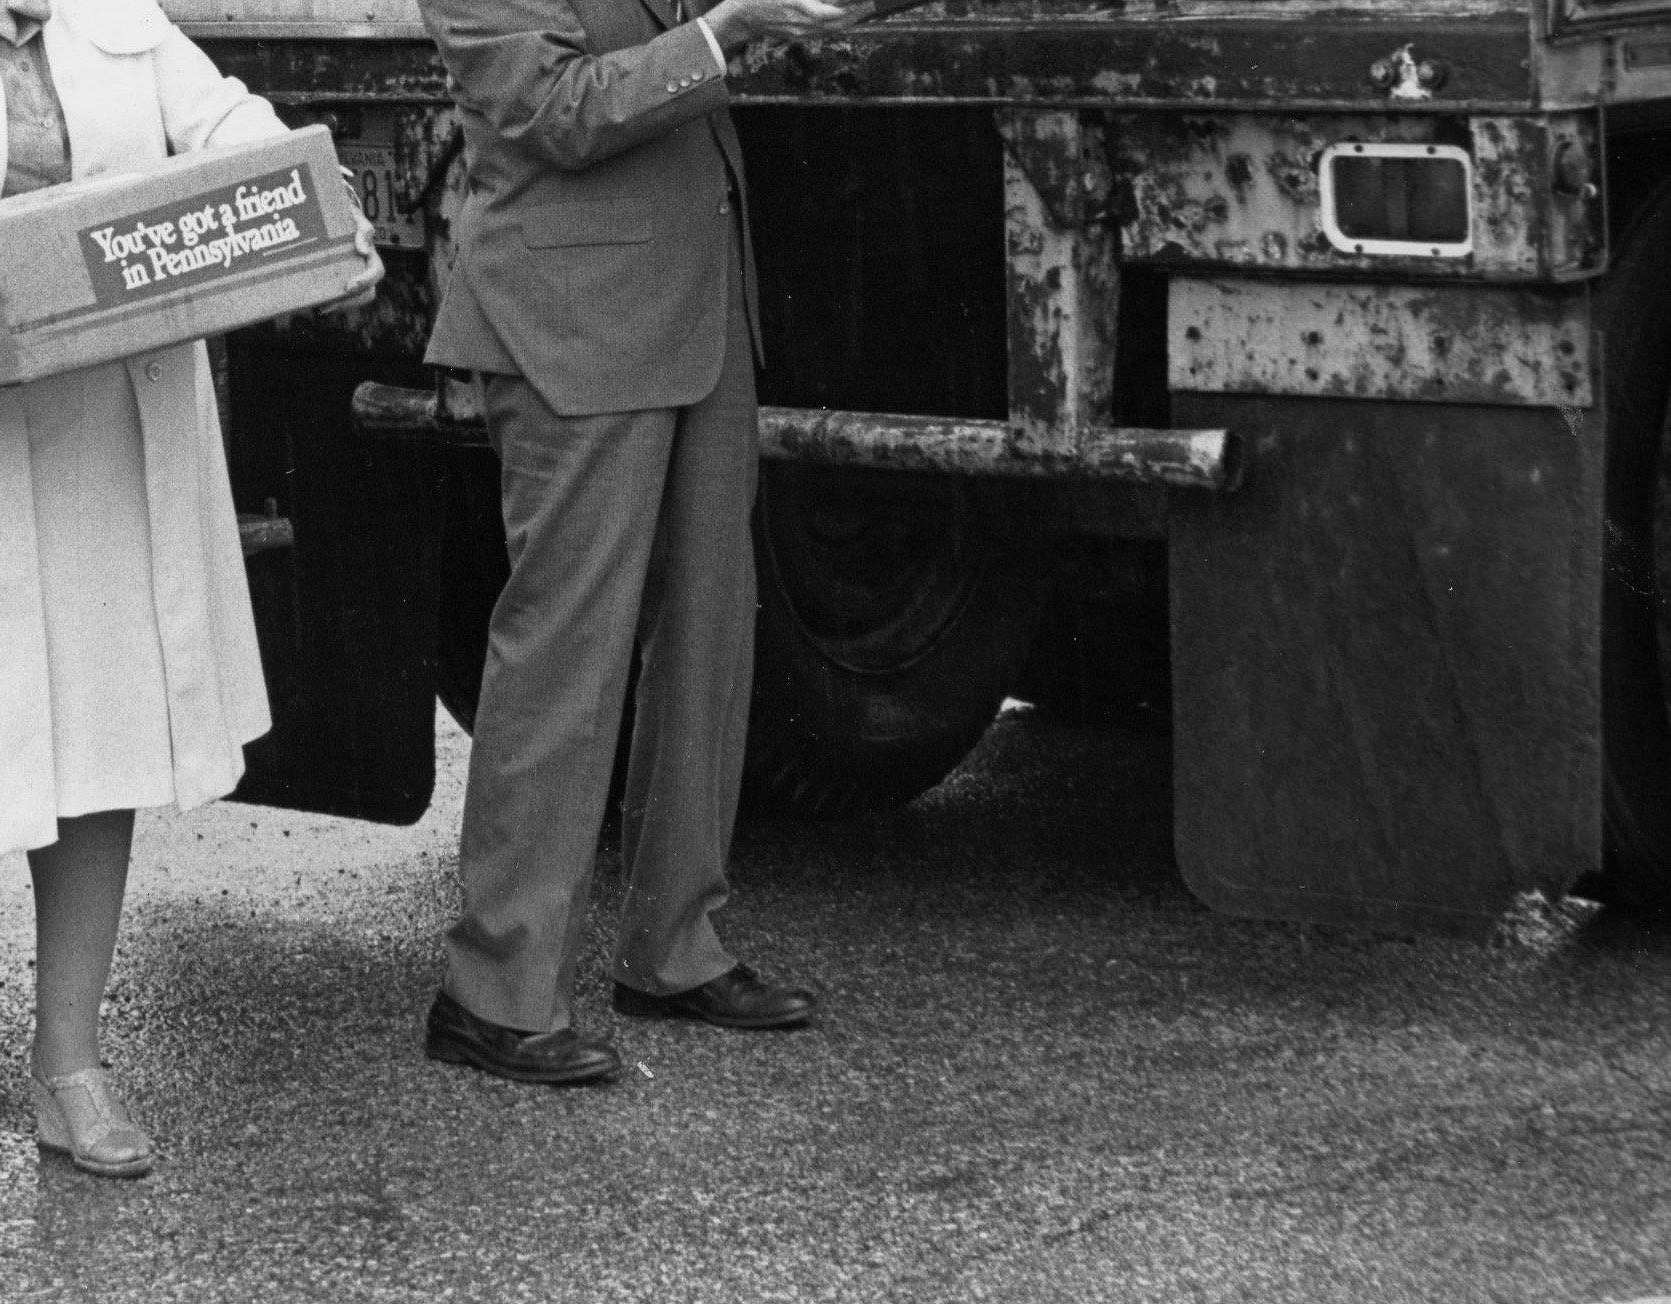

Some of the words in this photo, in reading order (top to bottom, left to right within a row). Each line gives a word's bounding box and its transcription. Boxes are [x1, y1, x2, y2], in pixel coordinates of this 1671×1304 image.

[90, 221, 177, 263] You've
[179, 204, 219, 247] got
[219, 203, 237, 227] a
[235, 169, 307, 222] friend
[120, 259, 151, 290] in
[147, 213, 300, 268] Pennsylvania
